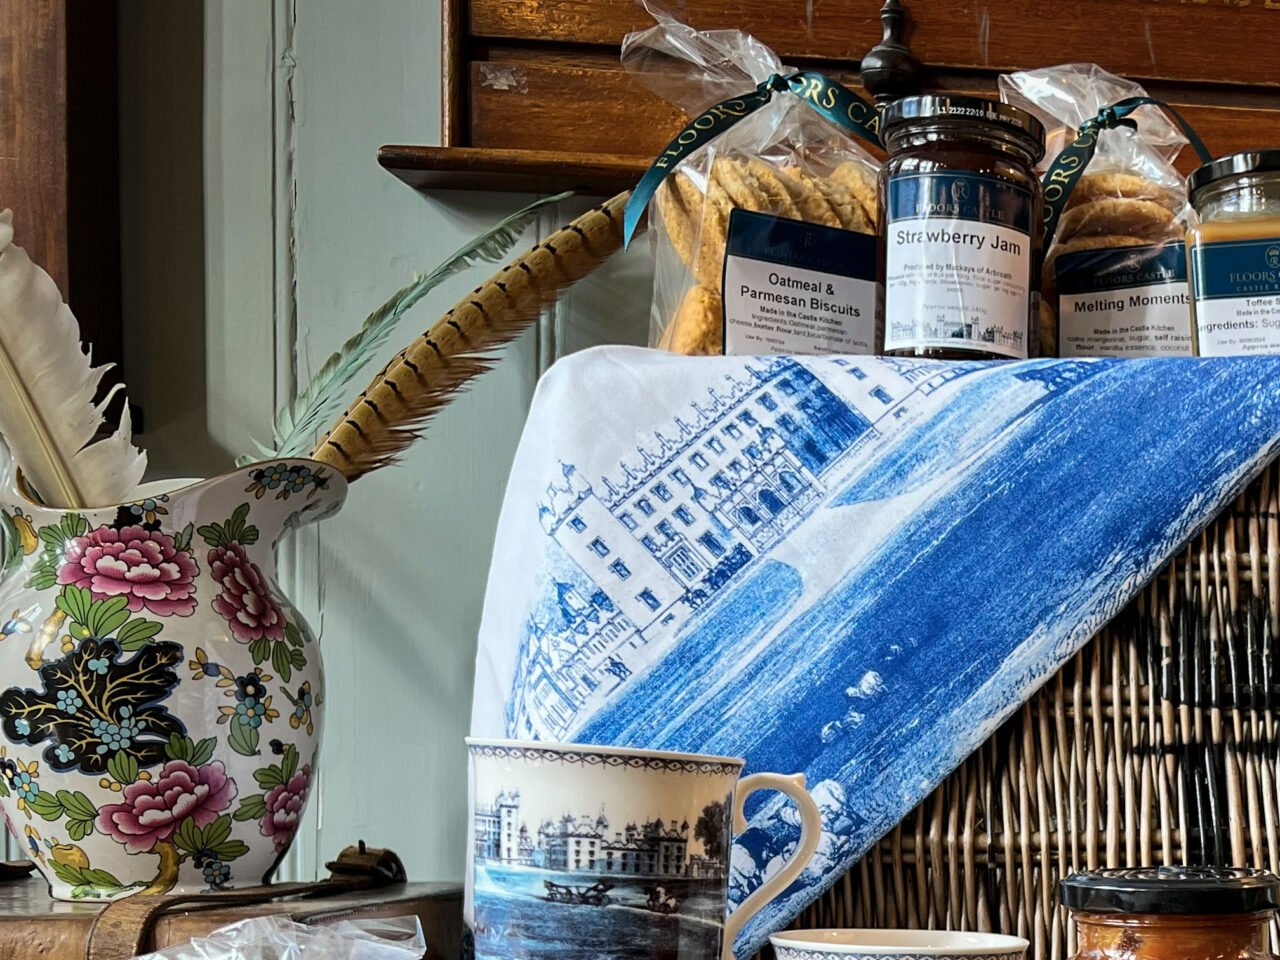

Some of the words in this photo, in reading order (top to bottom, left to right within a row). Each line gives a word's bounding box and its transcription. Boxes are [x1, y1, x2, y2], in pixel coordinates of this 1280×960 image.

[897, 229, 985, 250] Strawberry
[991, 235, 1021, 256] Jam
[1230, 271, 1276, 282] FLOORS
[769, 272, 822, 293] Oatmeal
[826, 284, 835, 295] &
[1237, 284, 1269, 292] CASTLE
[741, 285, 806, 307] Parmesan
[810, 298, 860, 317] Biscuits
[1074, 300, 1124, 312] Melting
[1246, 299, 1272, 307] Toffee
